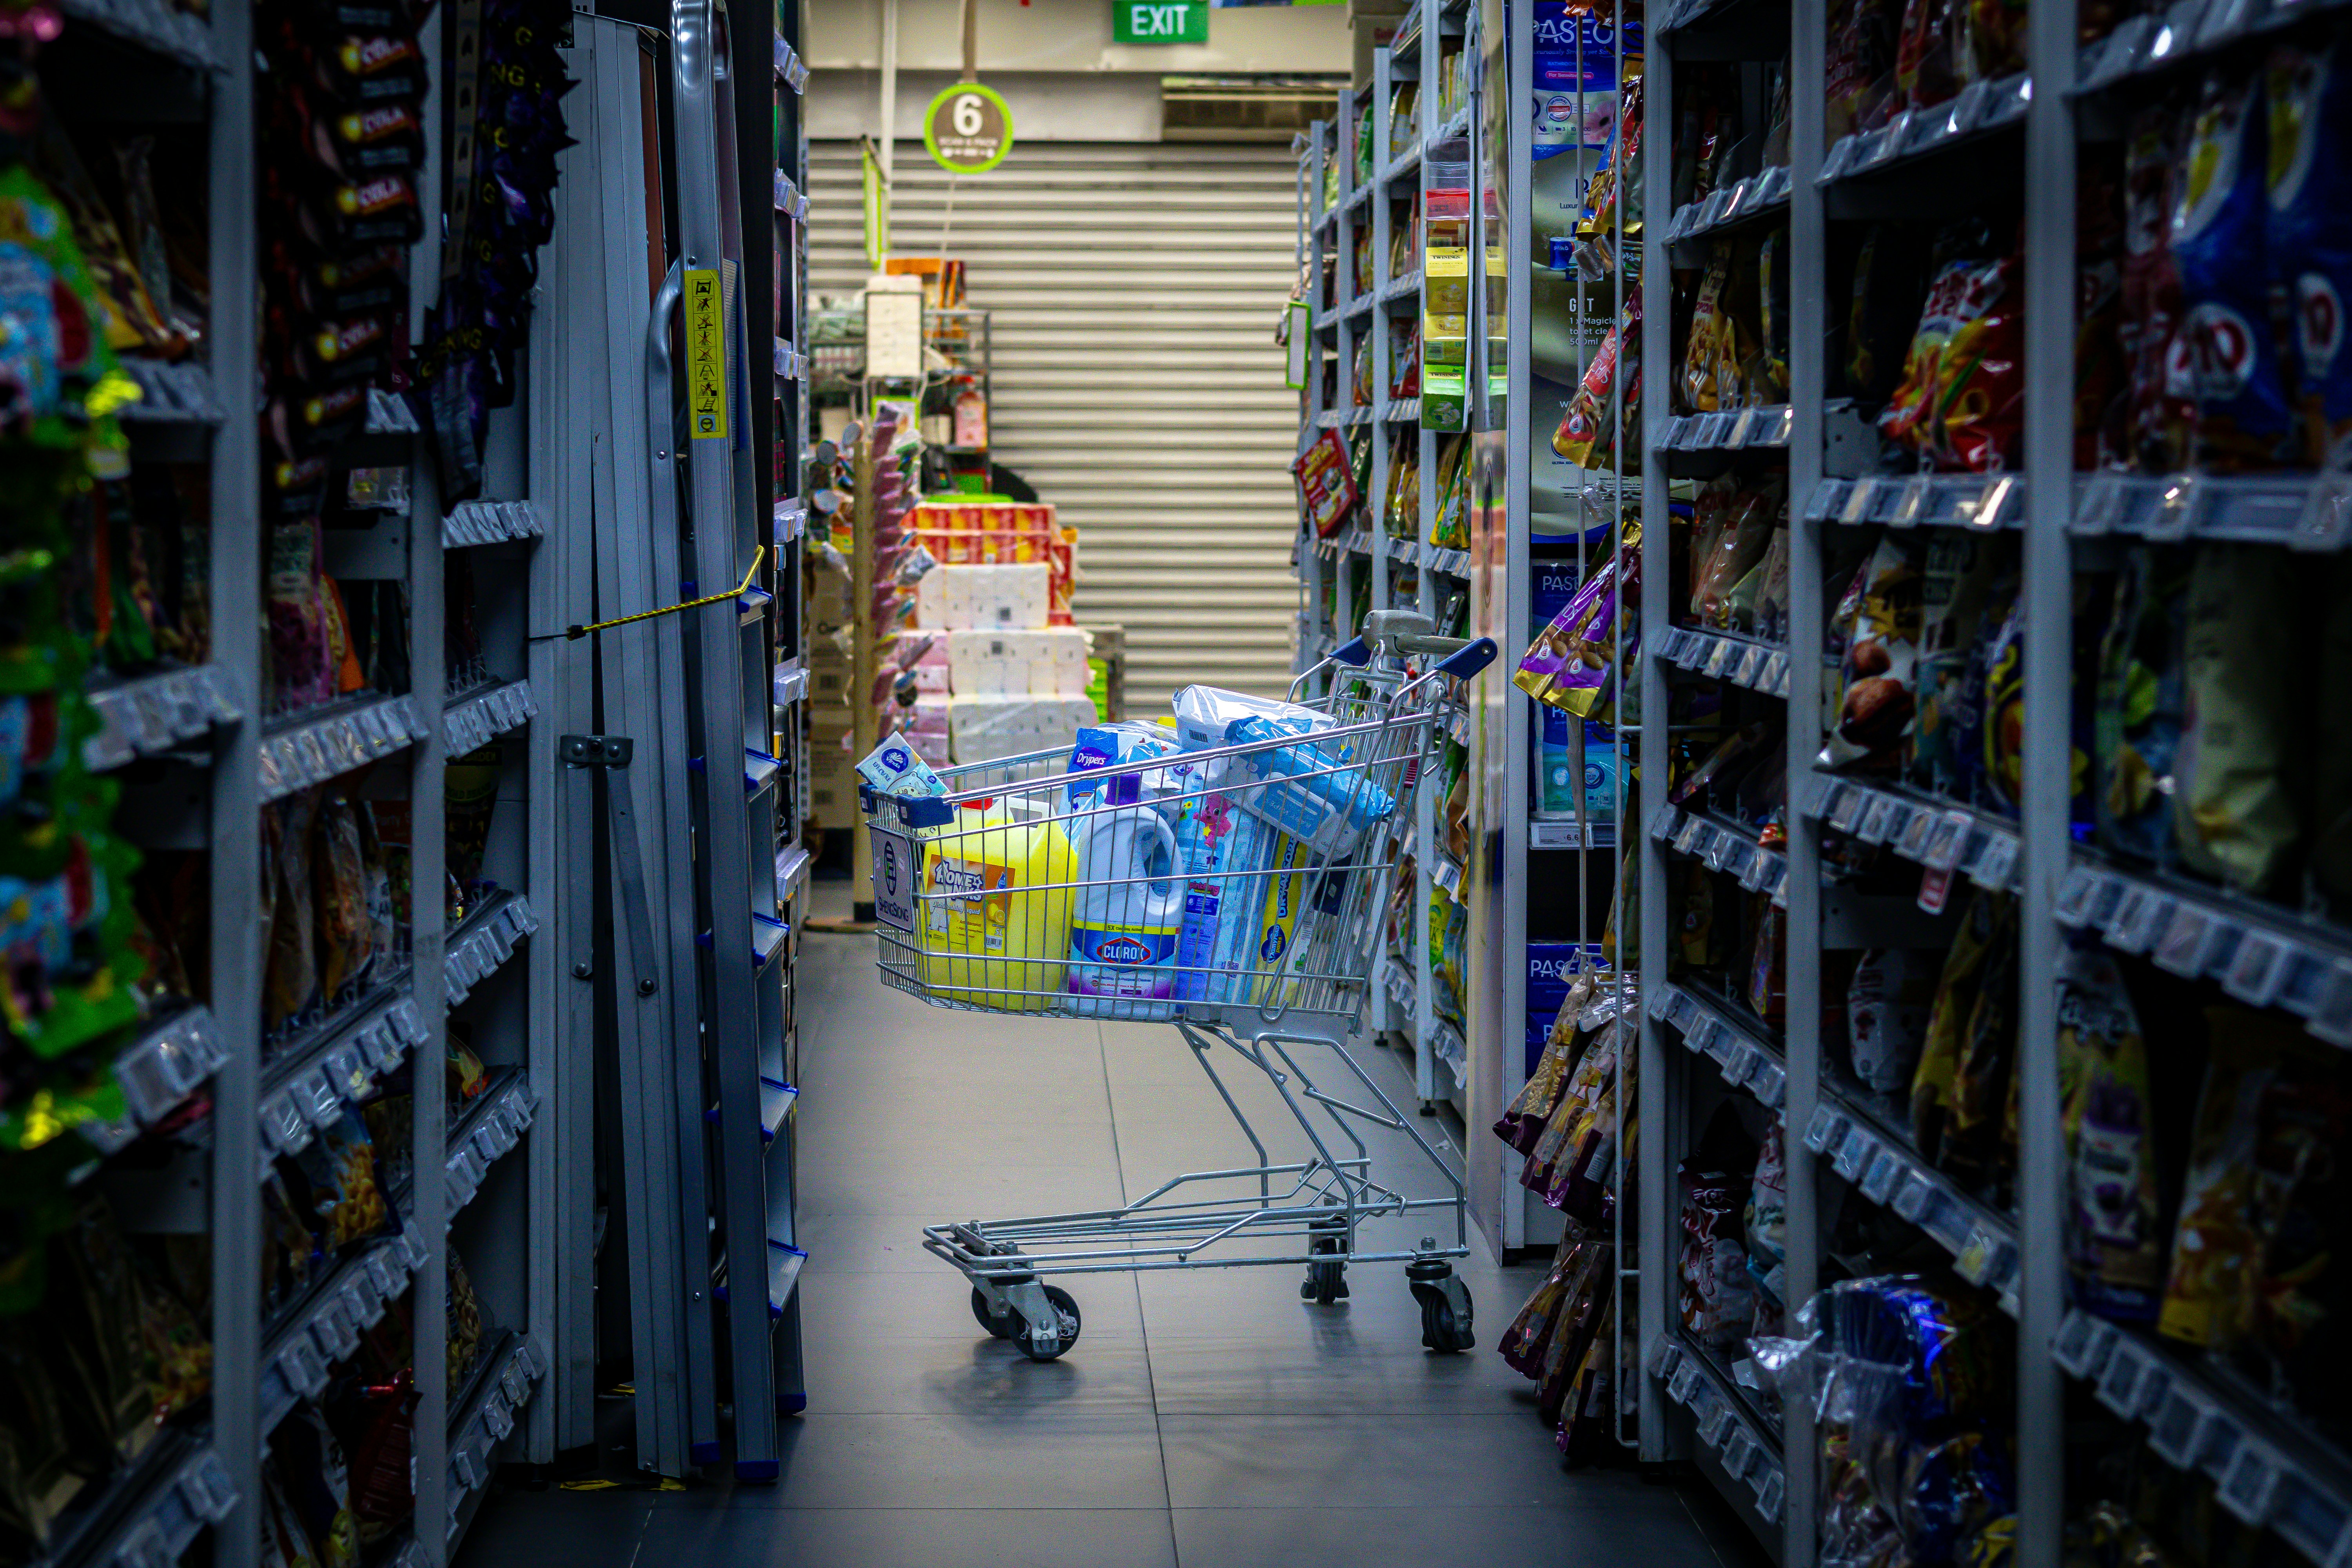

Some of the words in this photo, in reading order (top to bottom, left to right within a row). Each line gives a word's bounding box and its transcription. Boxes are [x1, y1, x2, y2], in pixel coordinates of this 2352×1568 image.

[1131, 4, 1189, 35] EXIT
[953, 94, 983, 136] 6
[1569, 298, 1594, 312] GT
[1584, 317, 1616, 327] Magicle
[1077, 752, 1106, 766] Drypers
[967, 907, 981, 915] iquid
[1103, 945, 1144, 960] CLOROX
